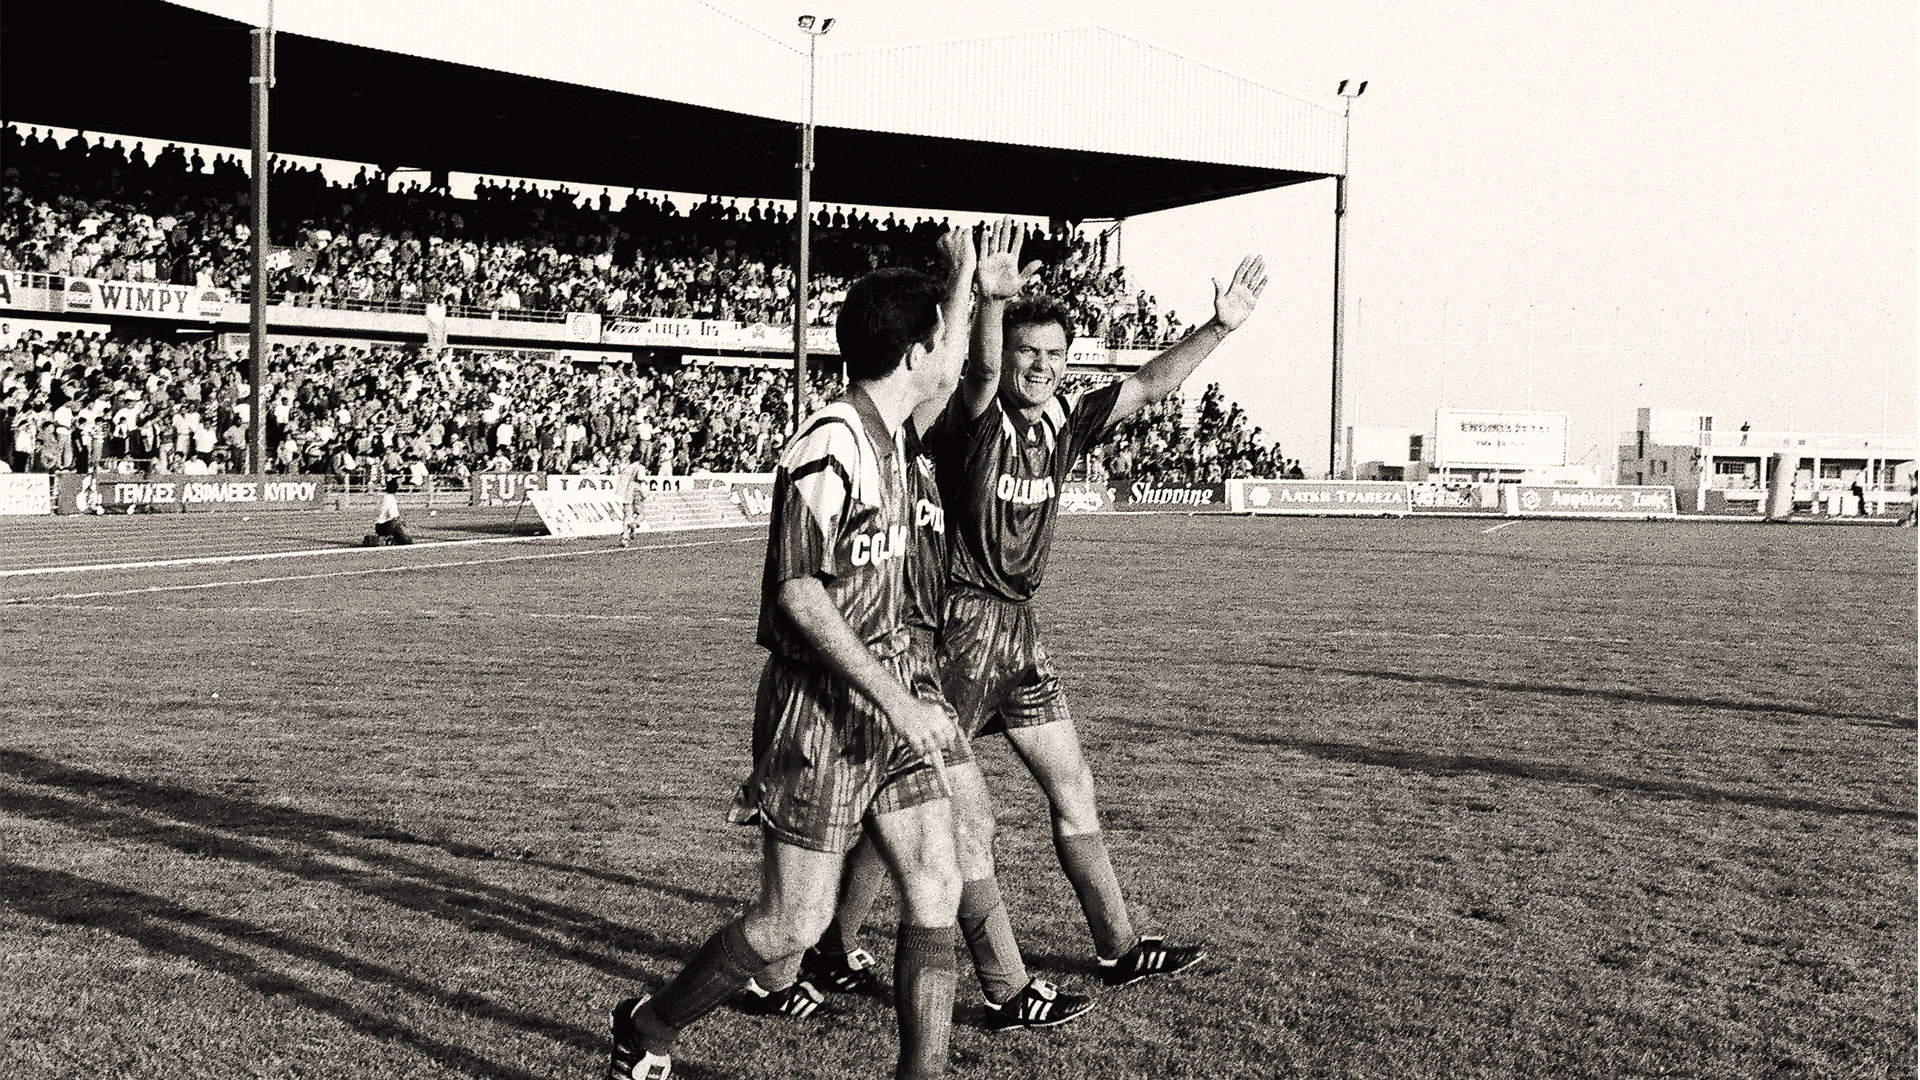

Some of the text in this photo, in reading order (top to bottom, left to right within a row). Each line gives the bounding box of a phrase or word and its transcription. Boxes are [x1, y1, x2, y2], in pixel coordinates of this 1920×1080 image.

[98, 284, 188, 313] WIMPY
[115, 482, 317, 503] ΓΕΝΙΚΕΣ ΑΣΦΑΛΕΙΕΣ ΚΥΠΡΟΥ
[1128, 480, 1214, 506] Shipping
